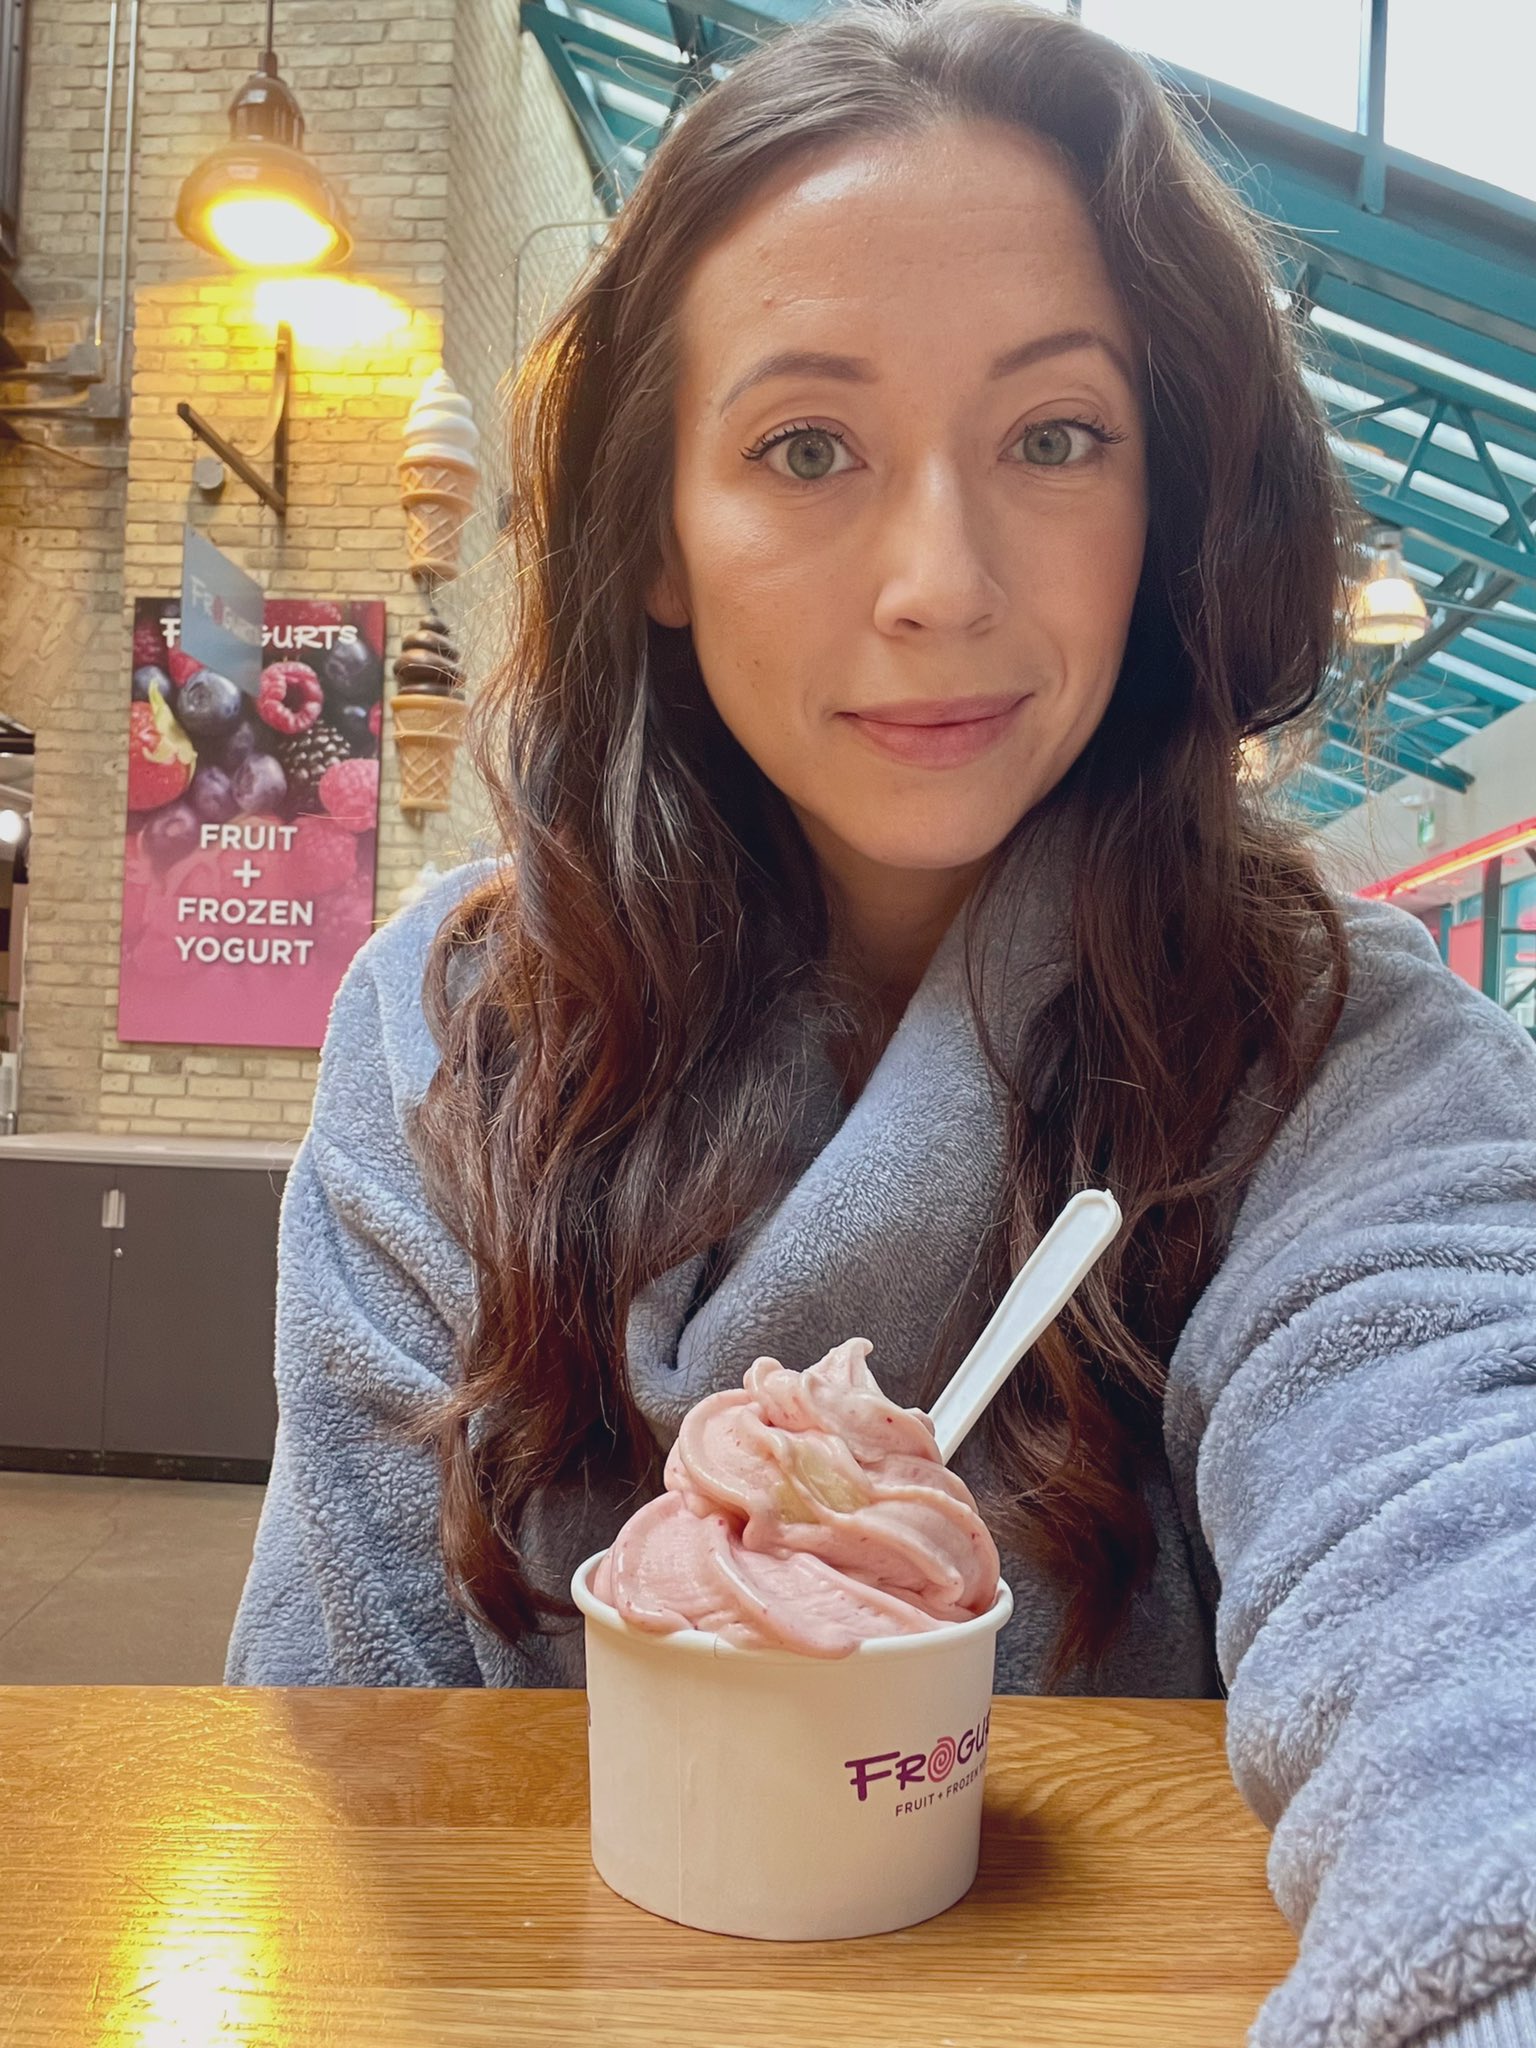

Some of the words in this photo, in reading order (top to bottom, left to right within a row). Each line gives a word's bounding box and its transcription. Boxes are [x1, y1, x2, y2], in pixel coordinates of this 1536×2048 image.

[160, 618, 358, 650] FURTS
[201, 824, 298, 851] FRUIT
[233, 859, 261, 888] +
[177, 897, 313, 926] FROZEN
[175, 936, 314, 965] YOGURT
[895, 1793, 935, 1817] FRUIT
[946, 1766, 979, 1799] FROZEN
